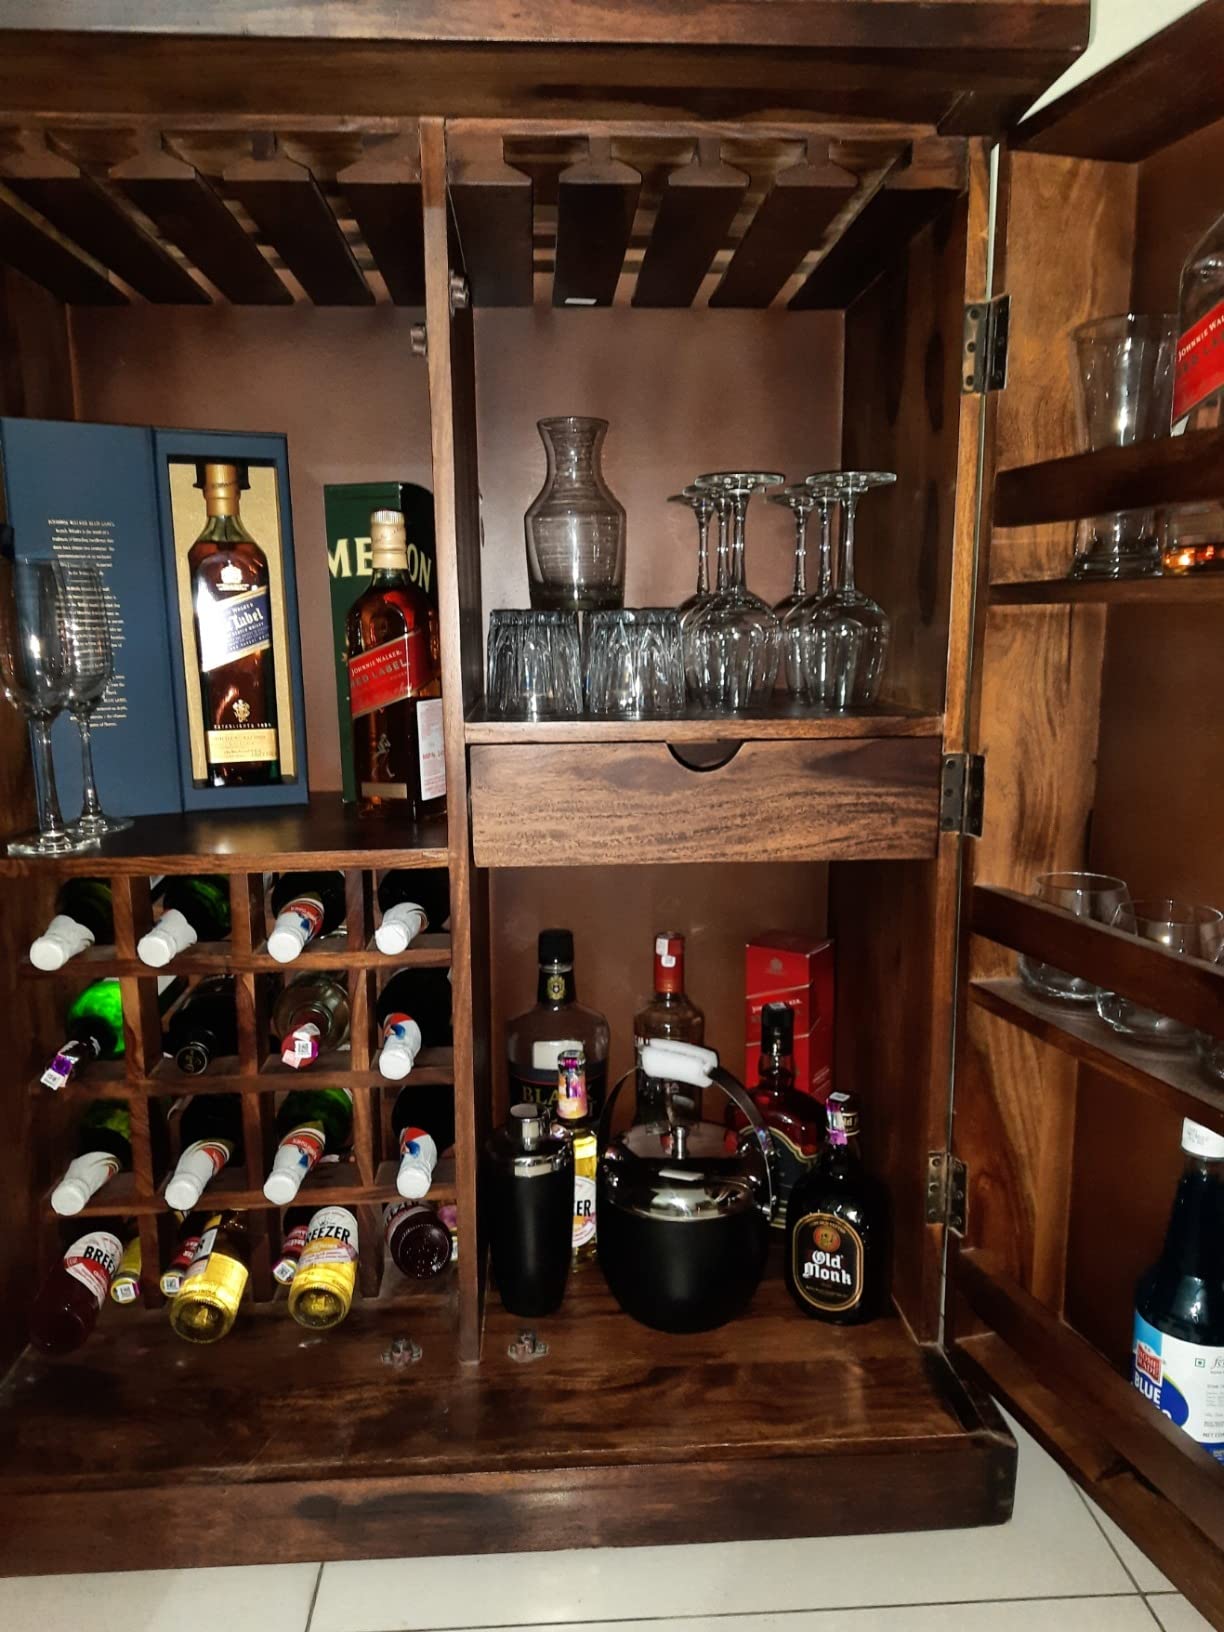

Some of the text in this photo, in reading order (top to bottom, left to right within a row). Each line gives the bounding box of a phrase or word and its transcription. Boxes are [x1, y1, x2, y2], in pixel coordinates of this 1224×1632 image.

[1178, 327, 1208, 362] JOHNNIE
[351, 660, 375, 677] JOHNNIE
[811, 1249, 837, 1269] Old
[803, 1261, 852, 1286] Monk
[1134, 1369, 1162, 1405] BLUE
